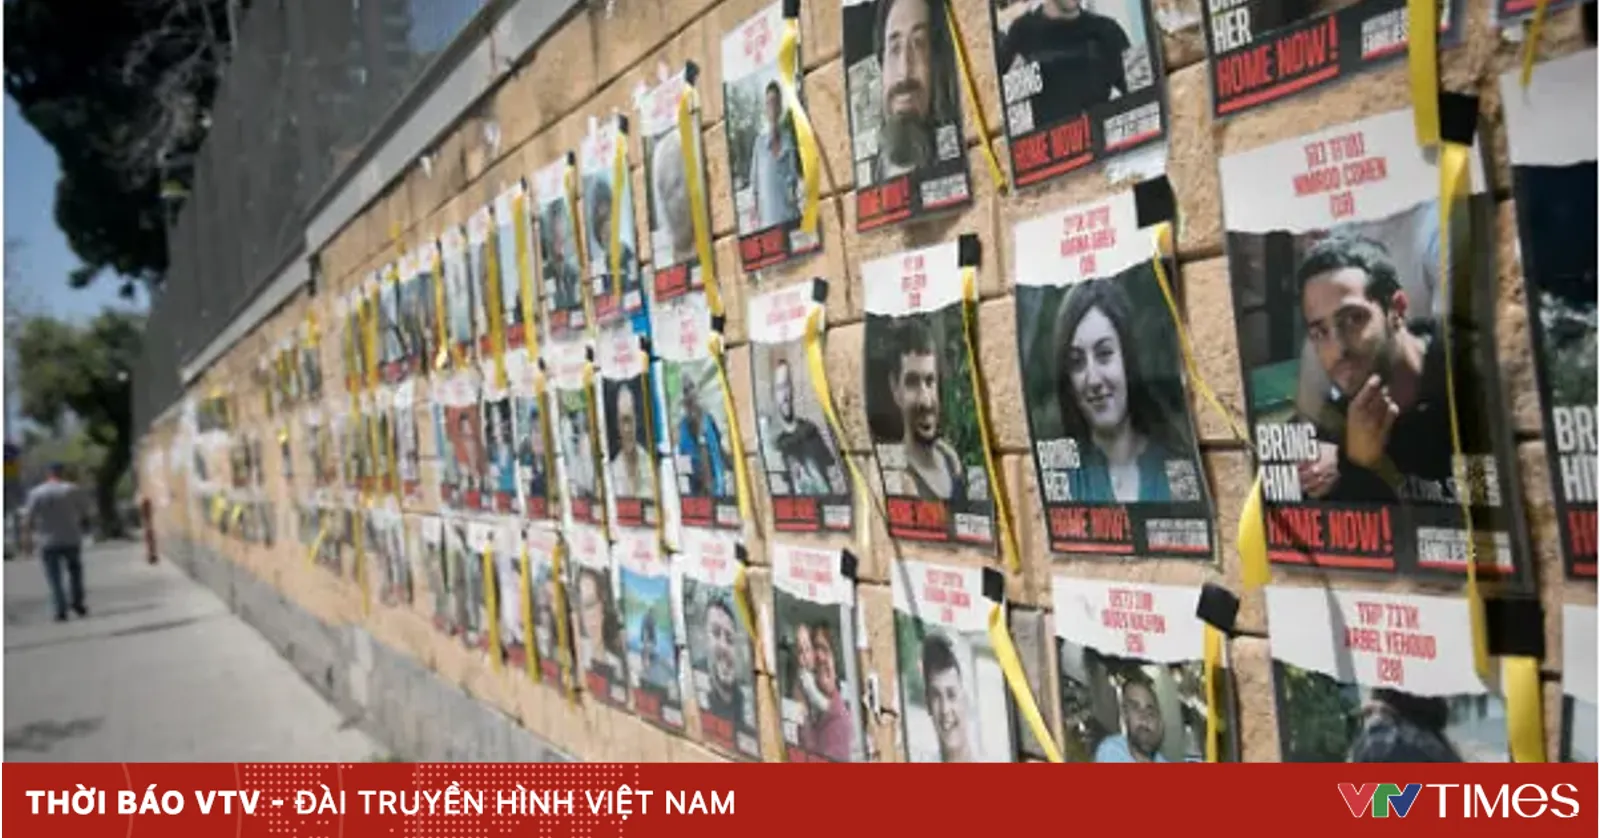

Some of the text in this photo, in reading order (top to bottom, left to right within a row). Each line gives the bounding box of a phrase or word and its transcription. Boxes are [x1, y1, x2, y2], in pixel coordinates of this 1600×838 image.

[1211, 7, 1253, 55] HER
[1217, 43, 1276, 97] HOME
[1275, 13, 1339, 78] NOW!
[1256, 421, 1320, 463] BRING
[1553, 404, 1598, 454] BR
[1036, 437, 1081, 470] BRING
[1260, 463, 1303, 503] HIM
[1266, 504, 1394, 554] HOME NOW!
